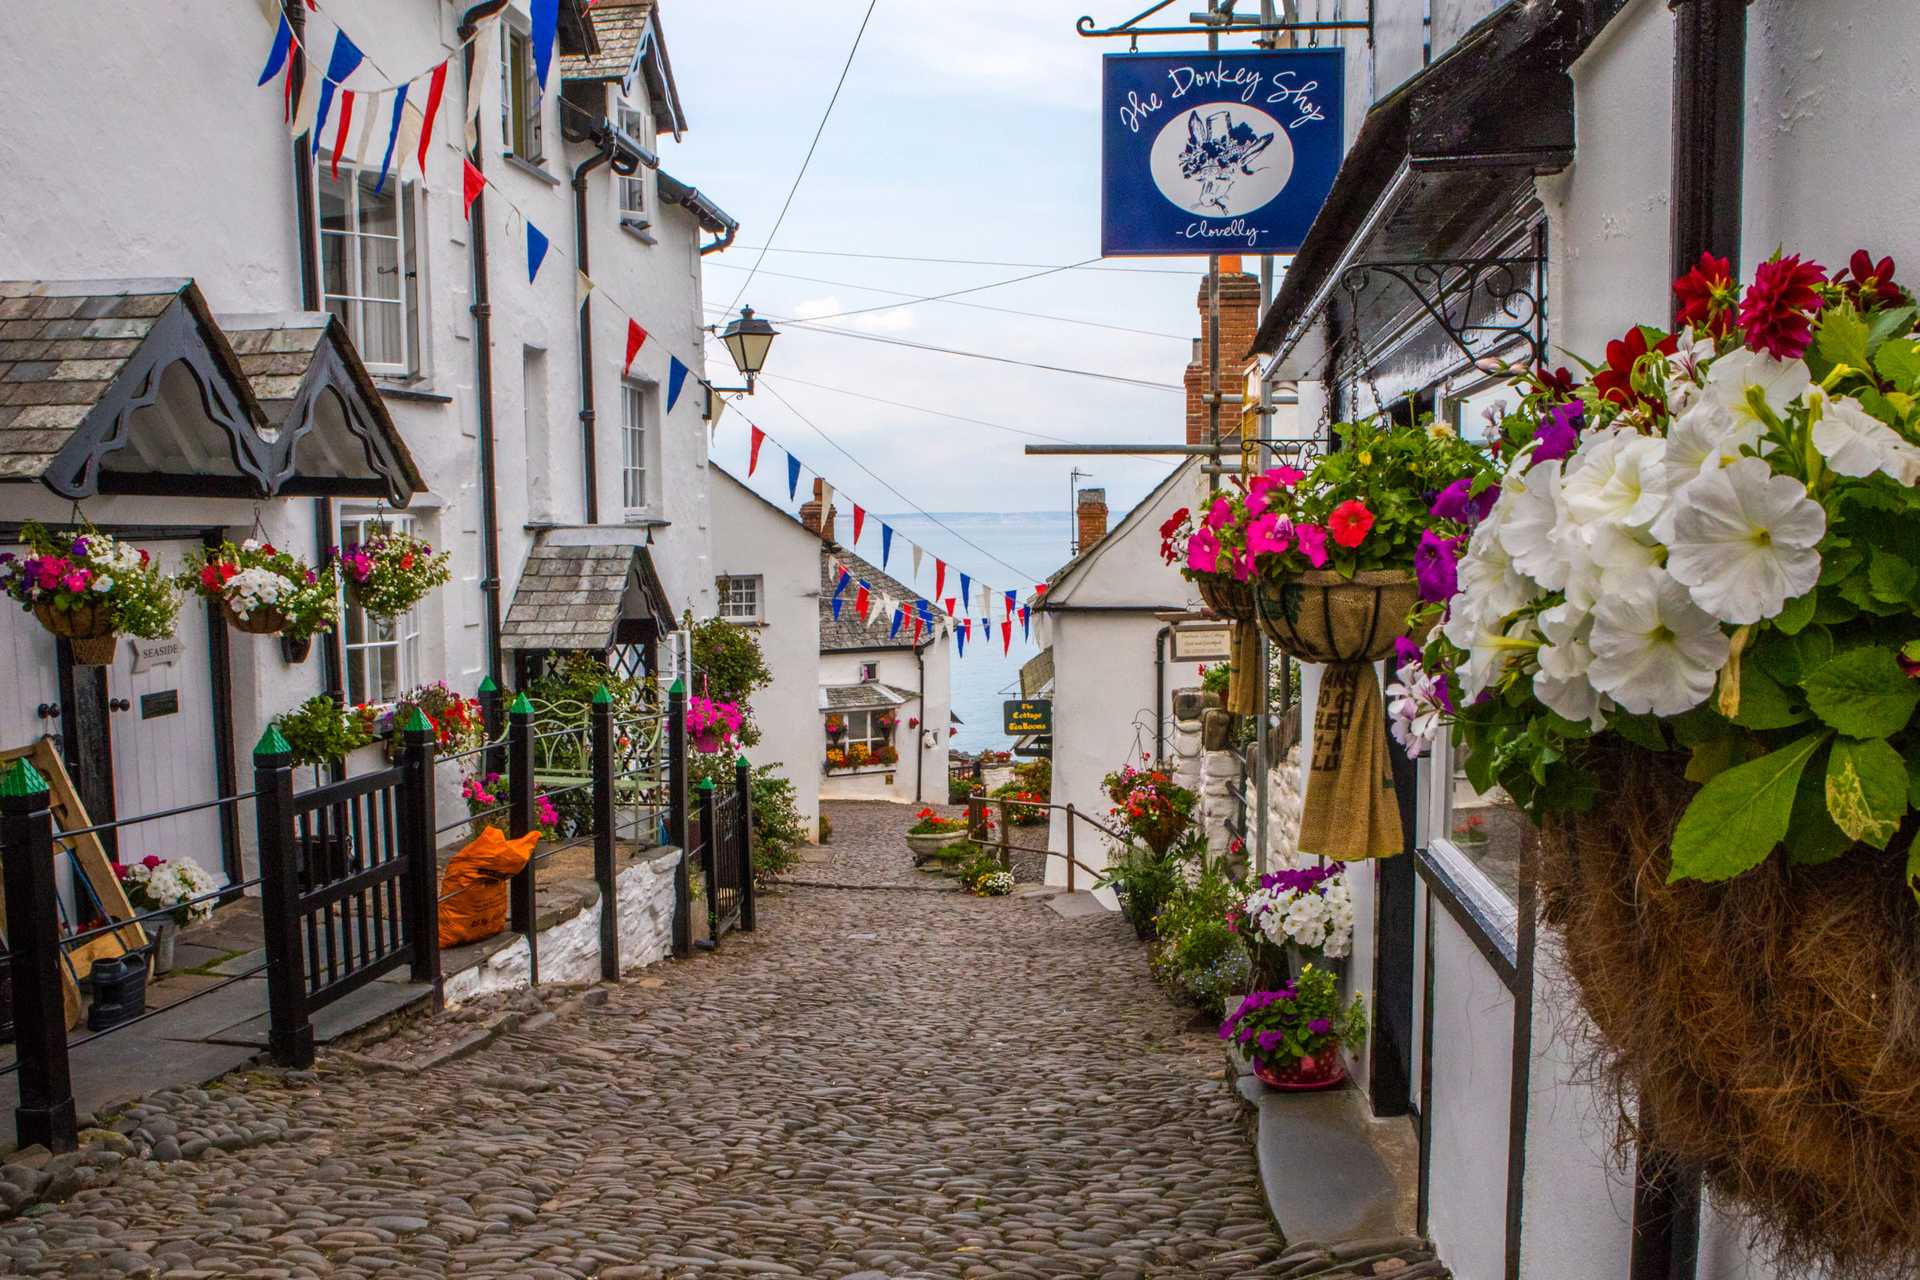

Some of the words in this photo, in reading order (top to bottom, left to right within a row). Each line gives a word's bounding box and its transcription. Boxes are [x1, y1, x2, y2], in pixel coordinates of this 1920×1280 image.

[1120, 91, 1162, 132] The
[1168, 60, 1263, 101] Donkey
[1266, 71, 1325, 128] Shop
[143, 643, 177, 658] SEASIDE
[1012, 711, 1042, 720] Cottage
